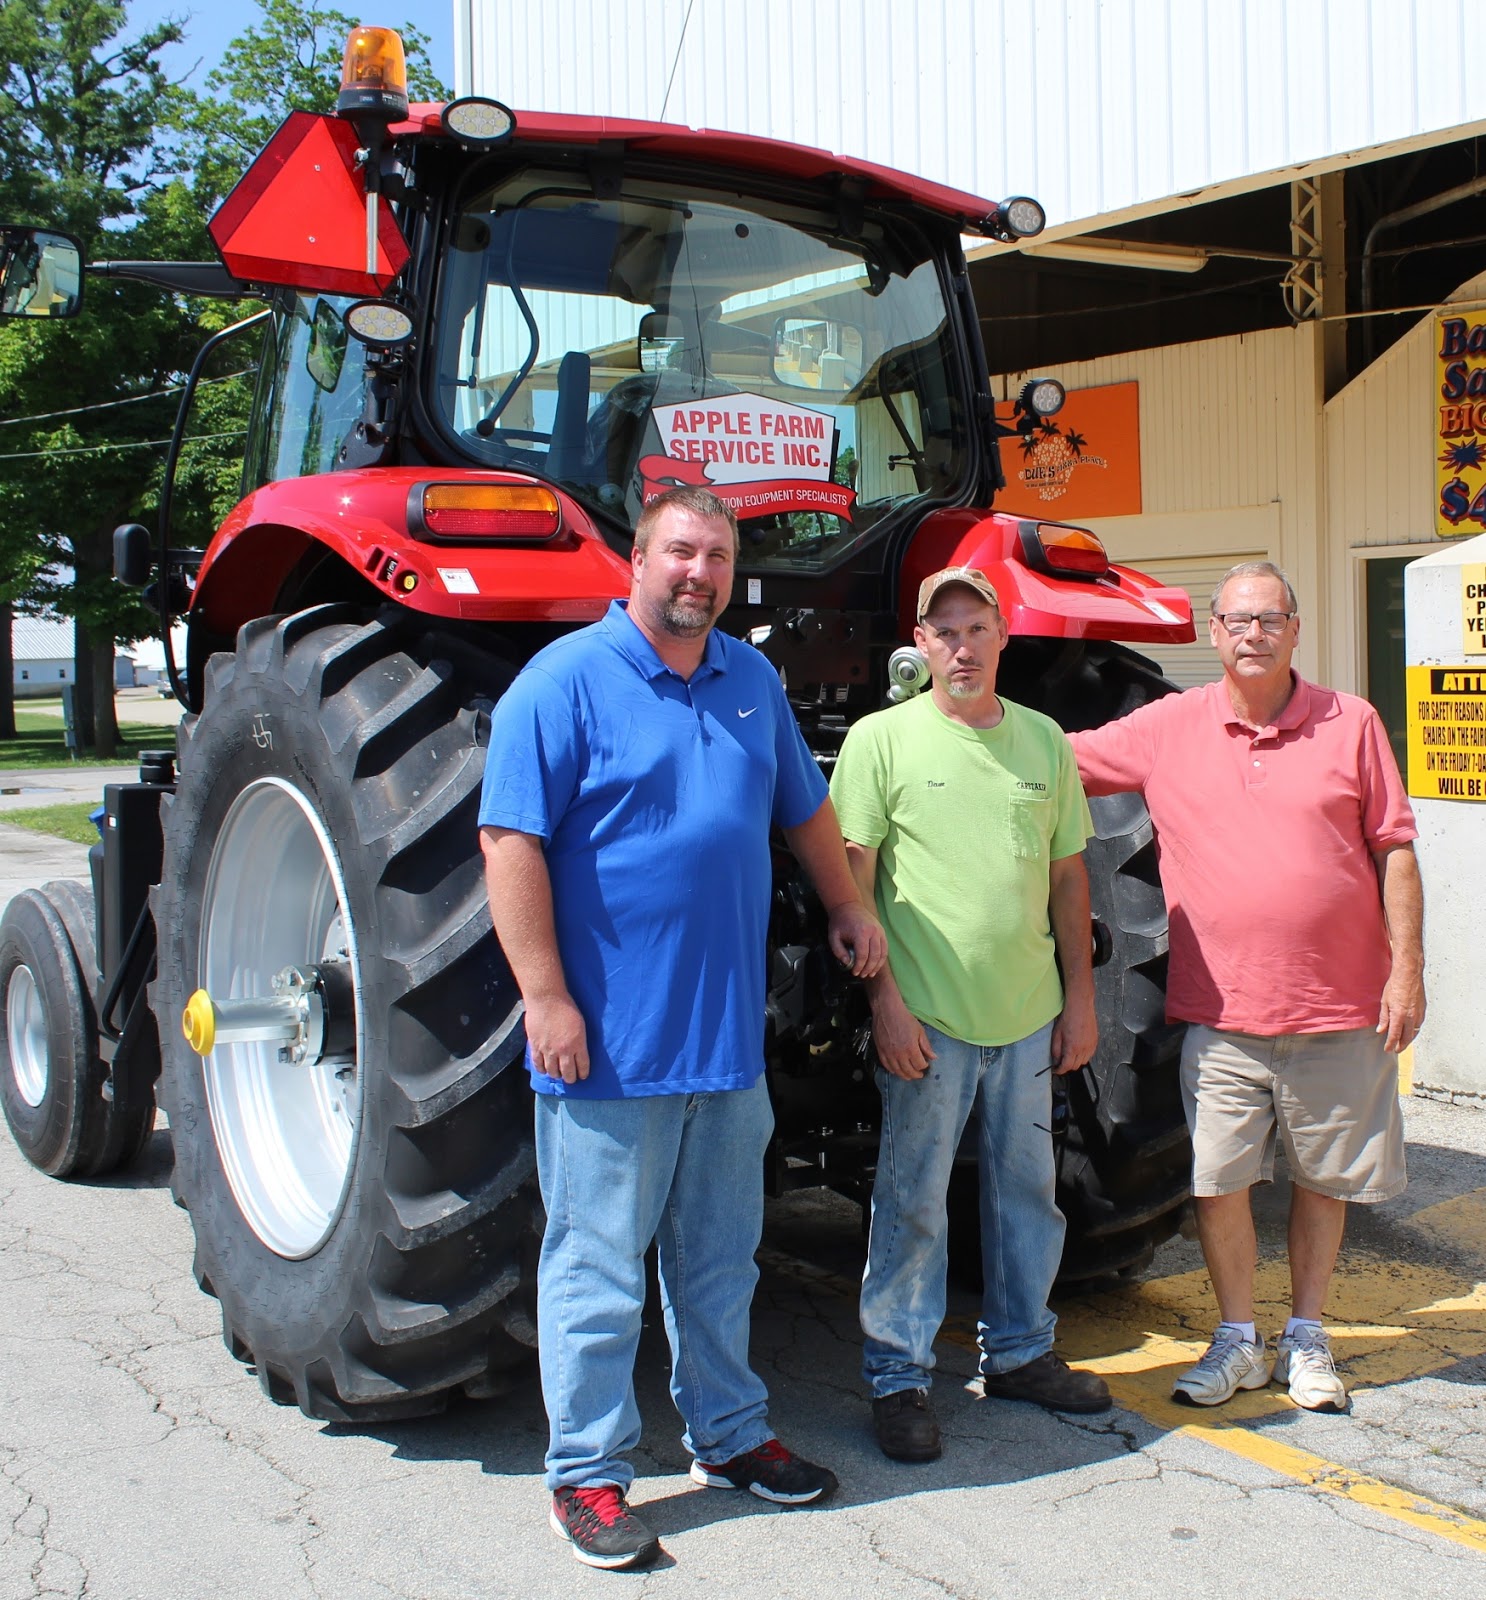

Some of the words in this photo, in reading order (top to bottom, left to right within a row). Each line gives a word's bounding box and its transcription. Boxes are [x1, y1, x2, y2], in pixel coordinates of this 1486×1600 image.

[672, 410, 751, 435] APPLE
[760, 414, 824, 439] FARM
[669, 439, 776, 465] SERVICE
[783, 443, 829, 467] INC.
[745, 490, 794, 507] EQUIPMENT
[796, 490, 848, 506] SPECIALISTS
[1467, 618, 1486, 632] YE
[1418, 701, 1430, 720] FOR
[1431, 701, 1453, 721] SAFETY
[1455, 702, 1484, 721] REASONS
[1423, 726, 1446, 745] CHAIRS
[1447, 727, 1456, 746] ON
[1457, 727, 1469, 746] THE
[1427, 752, 1435, 771] ON
[1437, 752, 1448, 771] THE
[1449, 752, 1471, 772] FRIDAY
[1438, 778, 1465, 795] WILL
[1468, 779, 1481, 796] BE
